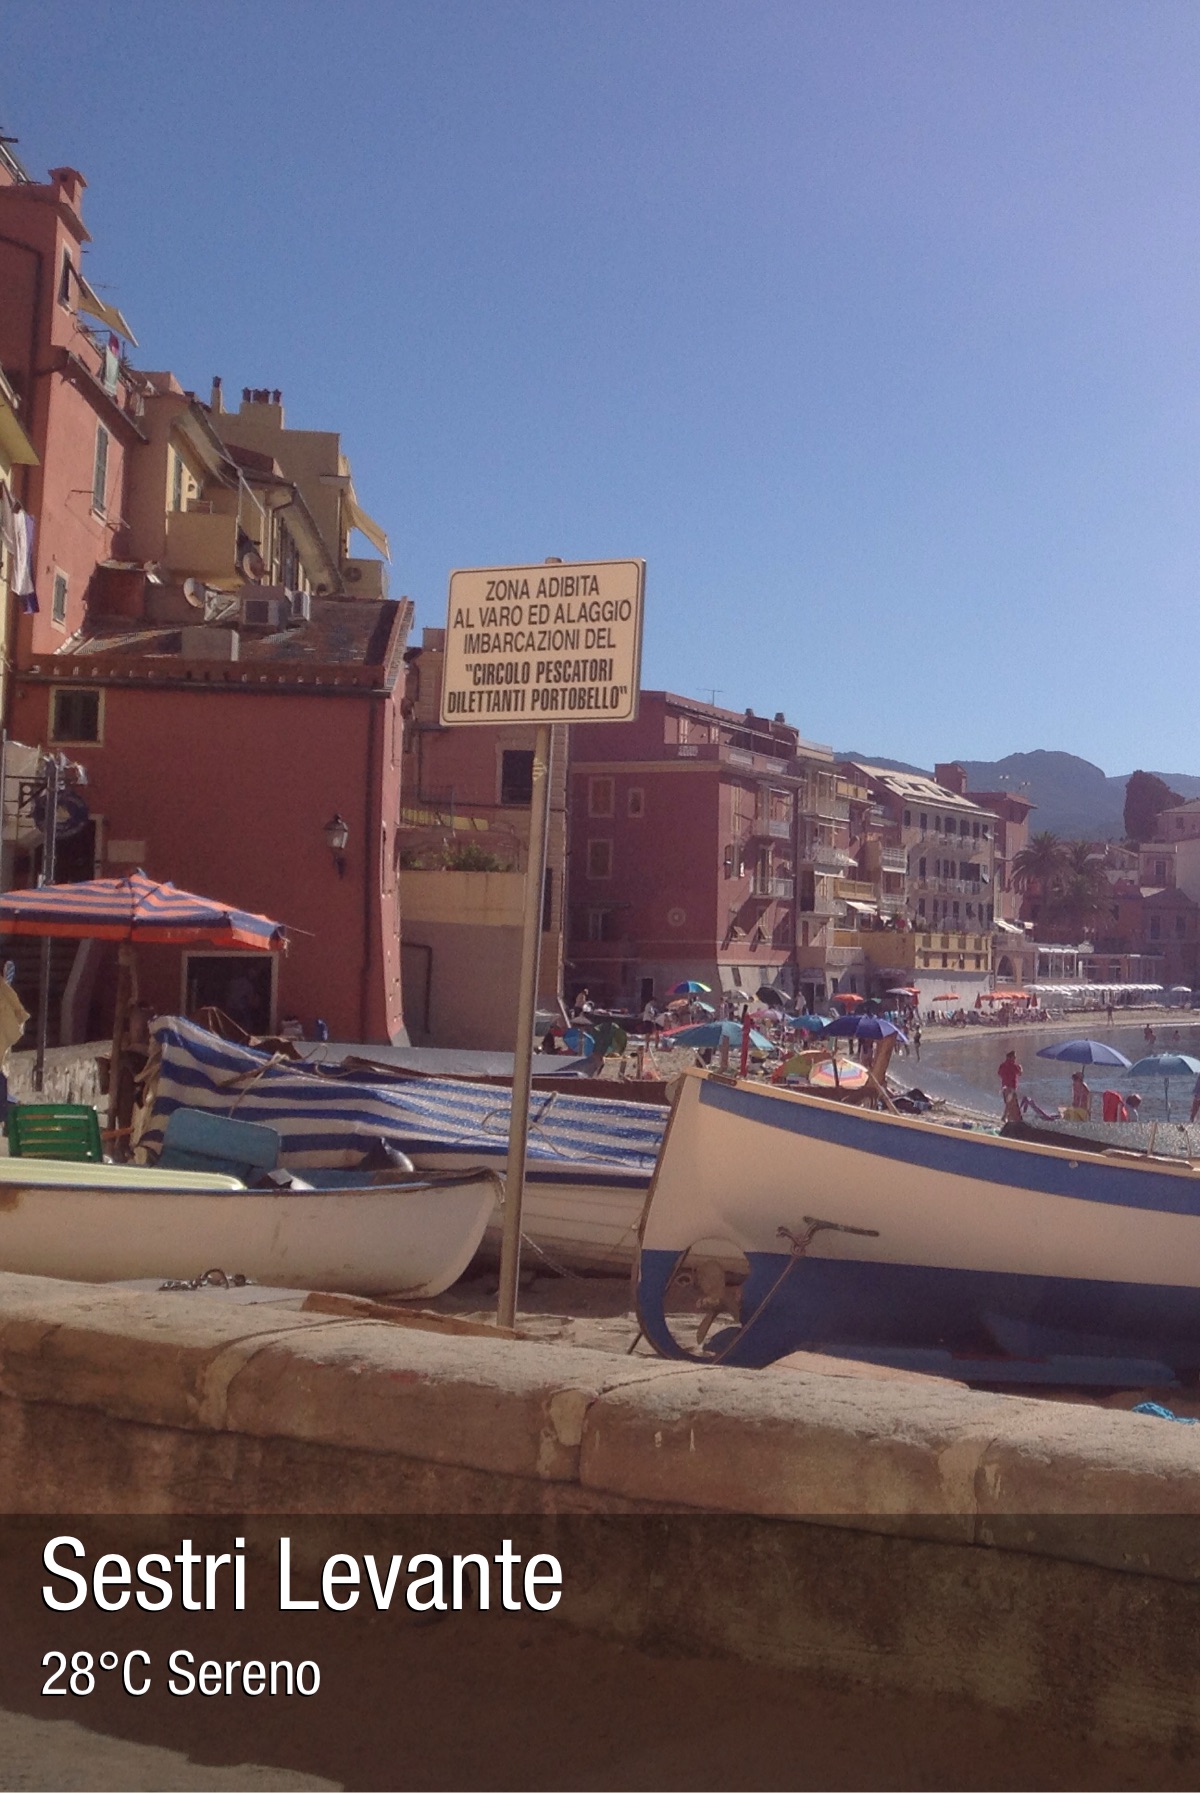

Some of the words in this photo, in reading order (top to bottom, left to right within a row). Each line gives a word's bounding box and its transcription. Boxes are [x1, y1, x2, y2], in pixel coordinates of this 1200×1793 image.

[485, 578, 530, 602] ZONA
[536, 574, 600, 600] ADIBITA
[453, 607, 475, 629] AL
[479, 604, 523, 627] VARO
[528, 603, 550, 625] ED
[554, 599, 632, 625] ALAGGIO
[463, 628, 580, 655] IMBARCAZIONI
[585, 627, 616, 650] DEL
[465, 661, 530, 686] "CIRCOLO
[535, 658, 614, 684] PESCATORI
[446, 689, 526, 714] DILETTANTI
[530, 685, 628, 711] PORTOBELLO"
